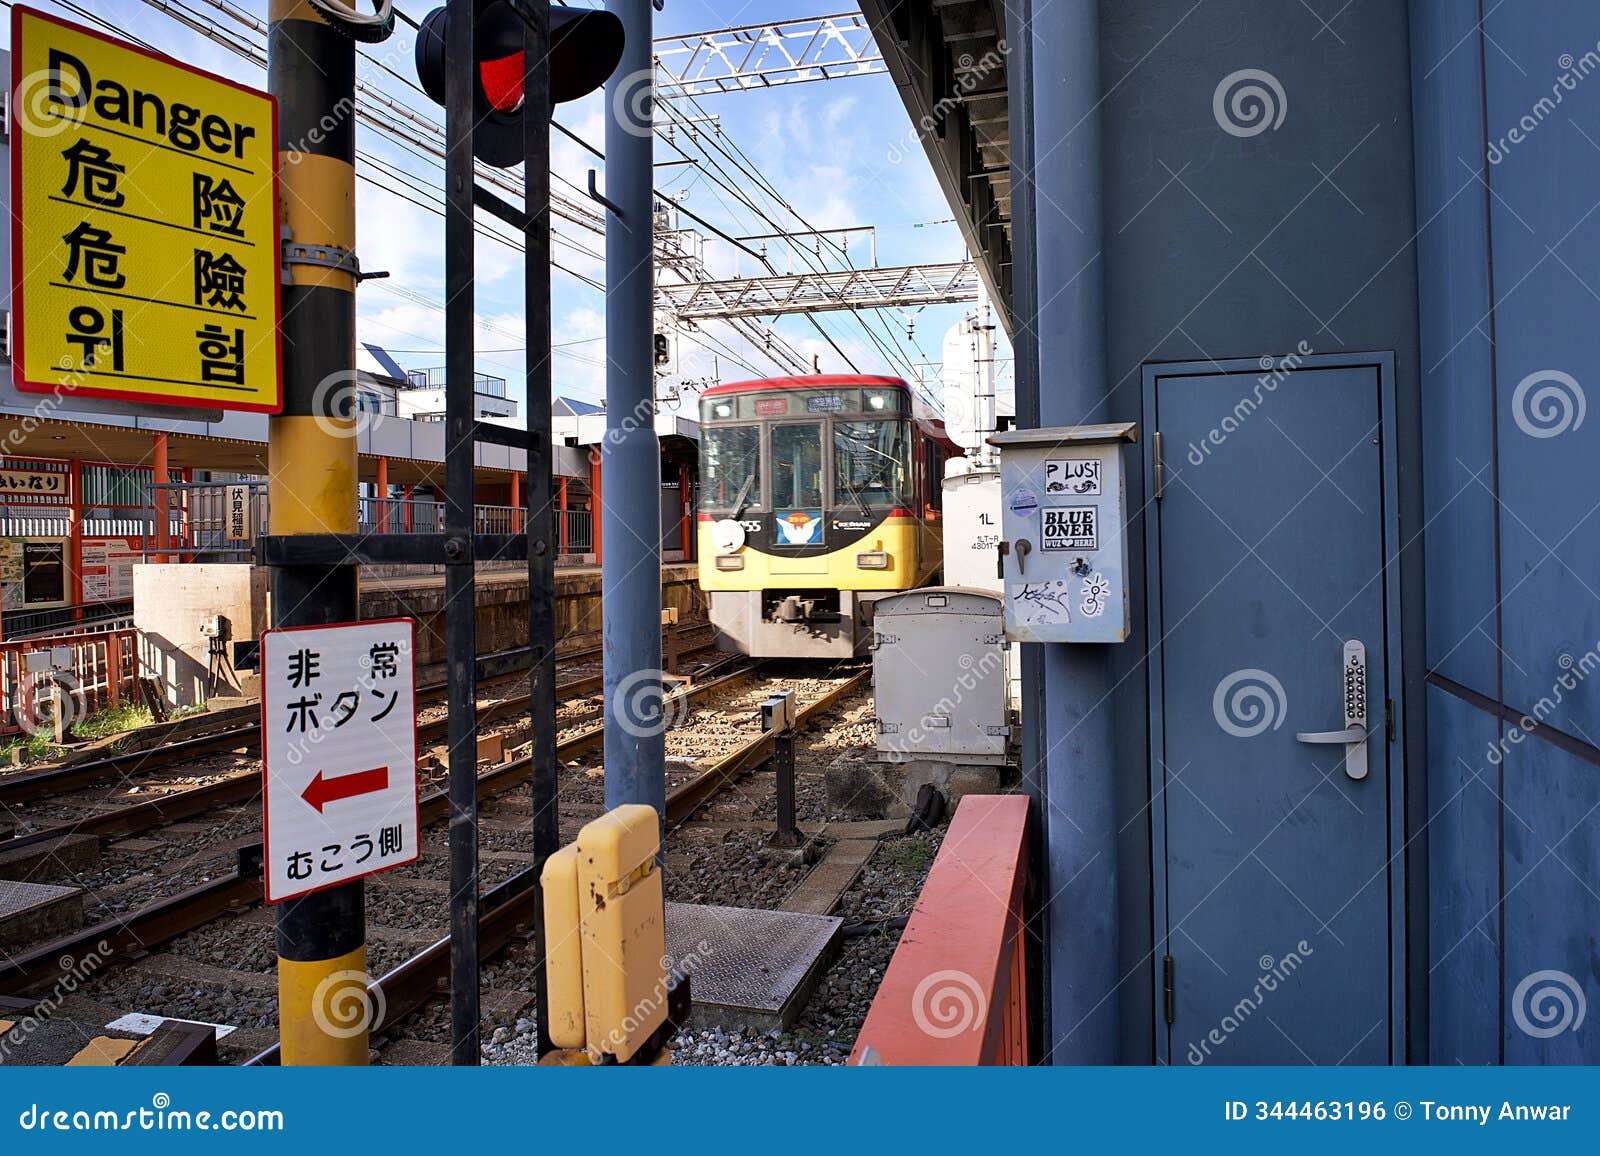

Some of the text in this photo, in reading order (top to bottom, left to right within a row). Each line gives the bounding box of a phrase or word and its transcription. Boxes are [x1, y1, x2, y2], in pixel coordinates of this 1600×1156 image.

[48, 47, 255, 159] Danger
[61, 137, 246, 238] 危险
[62, 221, 247, 313] 危險
[66, 305, 245, 386] 위험
[1047, 462, 1099, 480] P LUST
[232, 488, 243, 537] 伏見稲荷
[979, 513, 994, 525] 1L
[1045, 511, 1093, 524] BLUE
[1045, 524, 1094, 537] ONER
[287, 642, 399, 688] 非常
[286, 690, 399, 732] ボタン
[287, 823, 402, 880] むこう側
